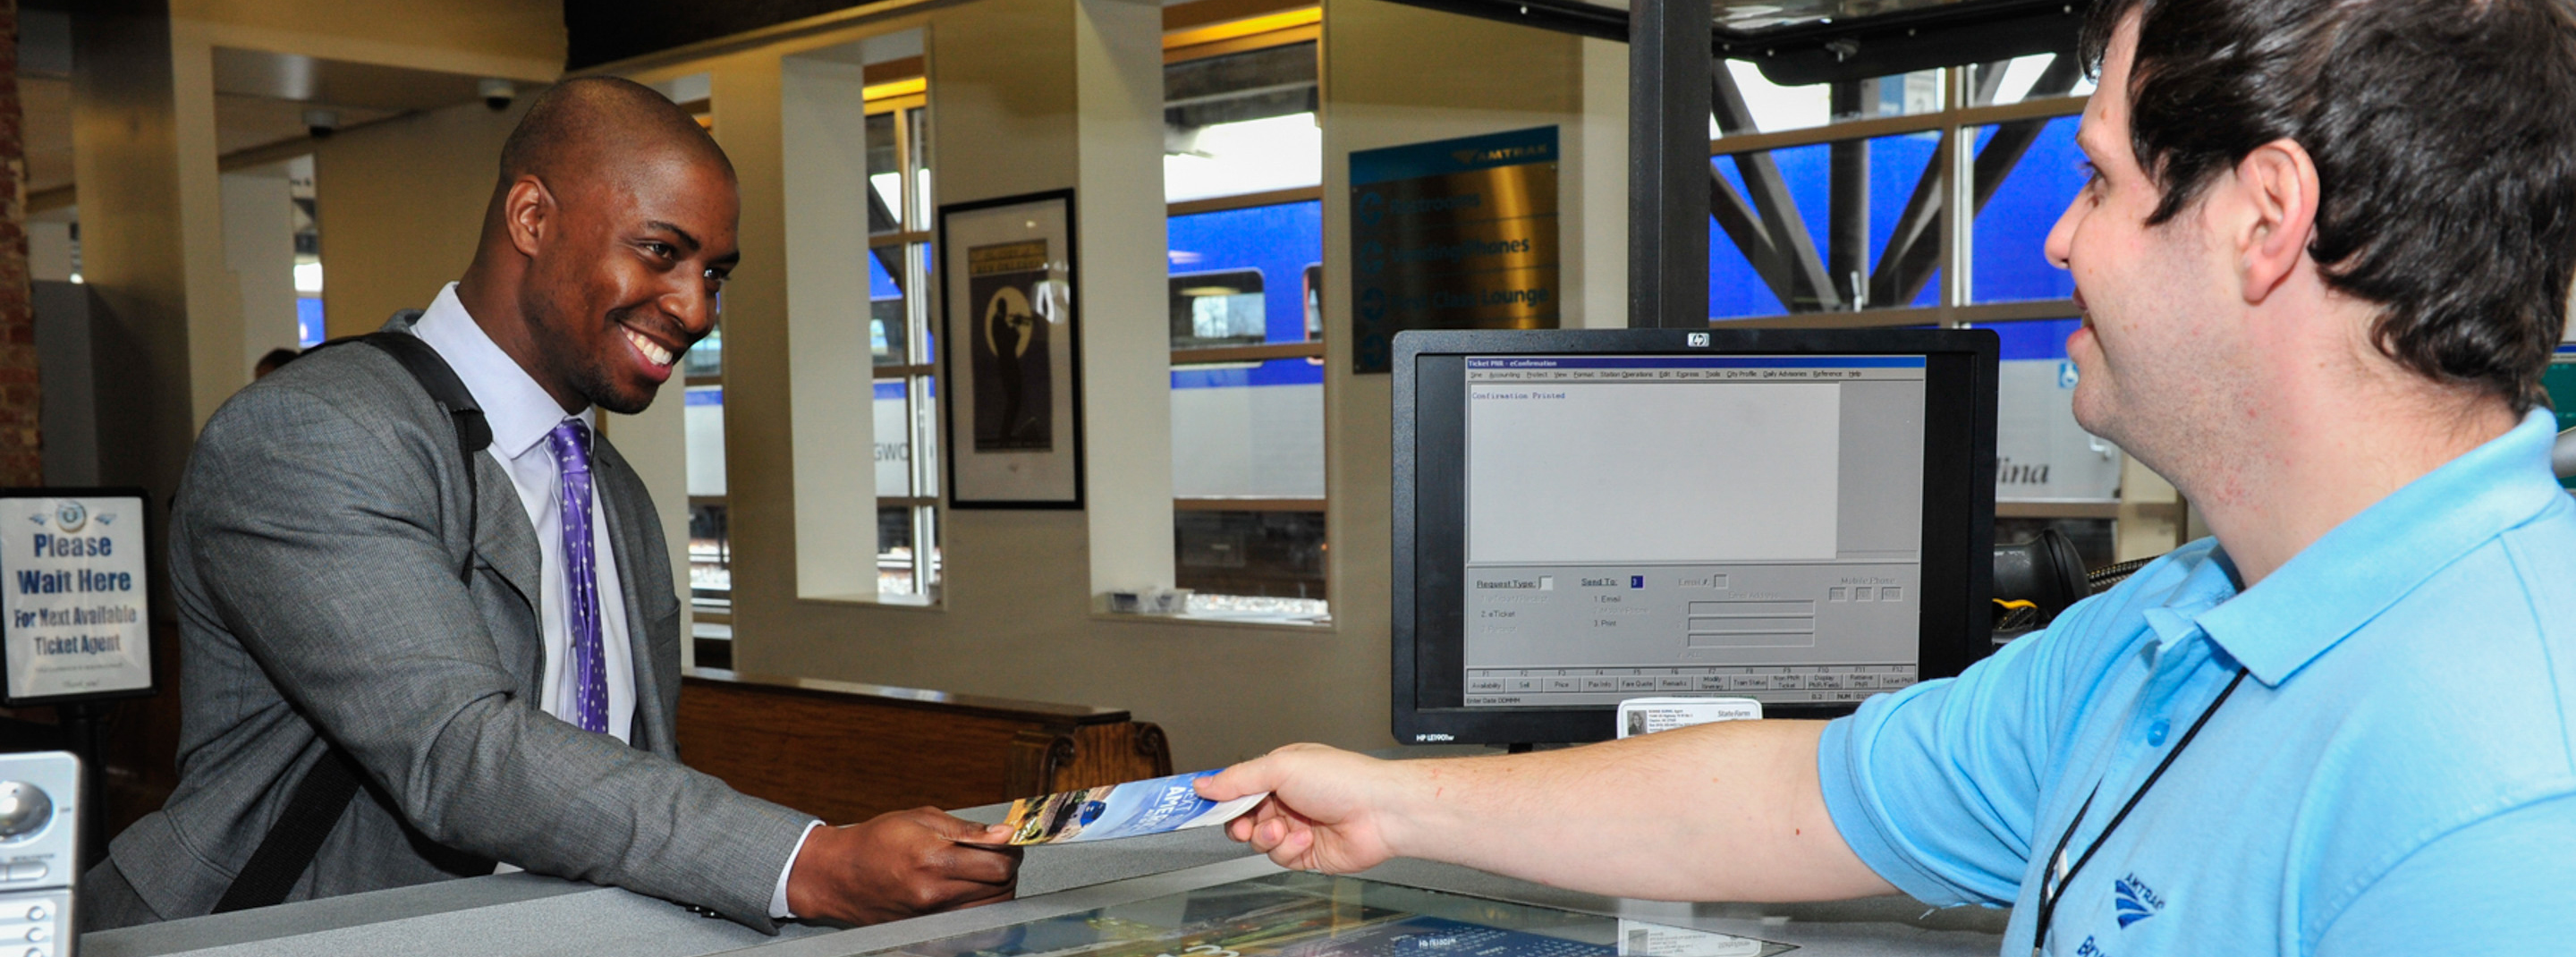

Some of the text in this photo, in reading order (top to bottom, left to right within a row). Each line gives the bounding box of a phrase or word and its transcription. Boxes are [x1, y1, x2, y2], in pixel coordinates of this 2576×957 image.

[1478, 145, 1546, 161] AMTRAK
[1391, 193, 1480, 215] Restrooms
[1481, 287, 1549, 308] Lounge
[1469, 360, 1489, 368] Ticket
[1510, 360, 1557, 368] eConfirmation
[1554, 370, 1567, 378] View
[1573, 370, 1594, 378] Format
[1600, 370, 1653, 378] Station Operations
[1659, 370, 1671, 378] Edit
[1676, 370, 1699, 378] Express
[1705, 370, 1720, 378] Tools
[1726, 370, 1757, 378] City Profile
[1763, 370, 1776, 378] Daily
[1813, 370, 1843, 378] Reference
[1849, 370, 1861, 378] Help
[1472, 392, 1565, 400] Confirmation Printed
[33, 533, 112, 557] Please
[17, 569, 131, 595] Wait Here
[1477, 580, 1536, 589] Request Type:
[1581, 578, 1617, 586] Send To:
[14, 605, 137, 628] For Next Available
[1488, 610, 1515, 618] eTicket
[35, 634, 122, 656] Ticket Agent
[1898, 676, 1914, 684] PNR
[1472, 682, 1501, 690] Availability
[1416, 733, 1426, 741] HP
